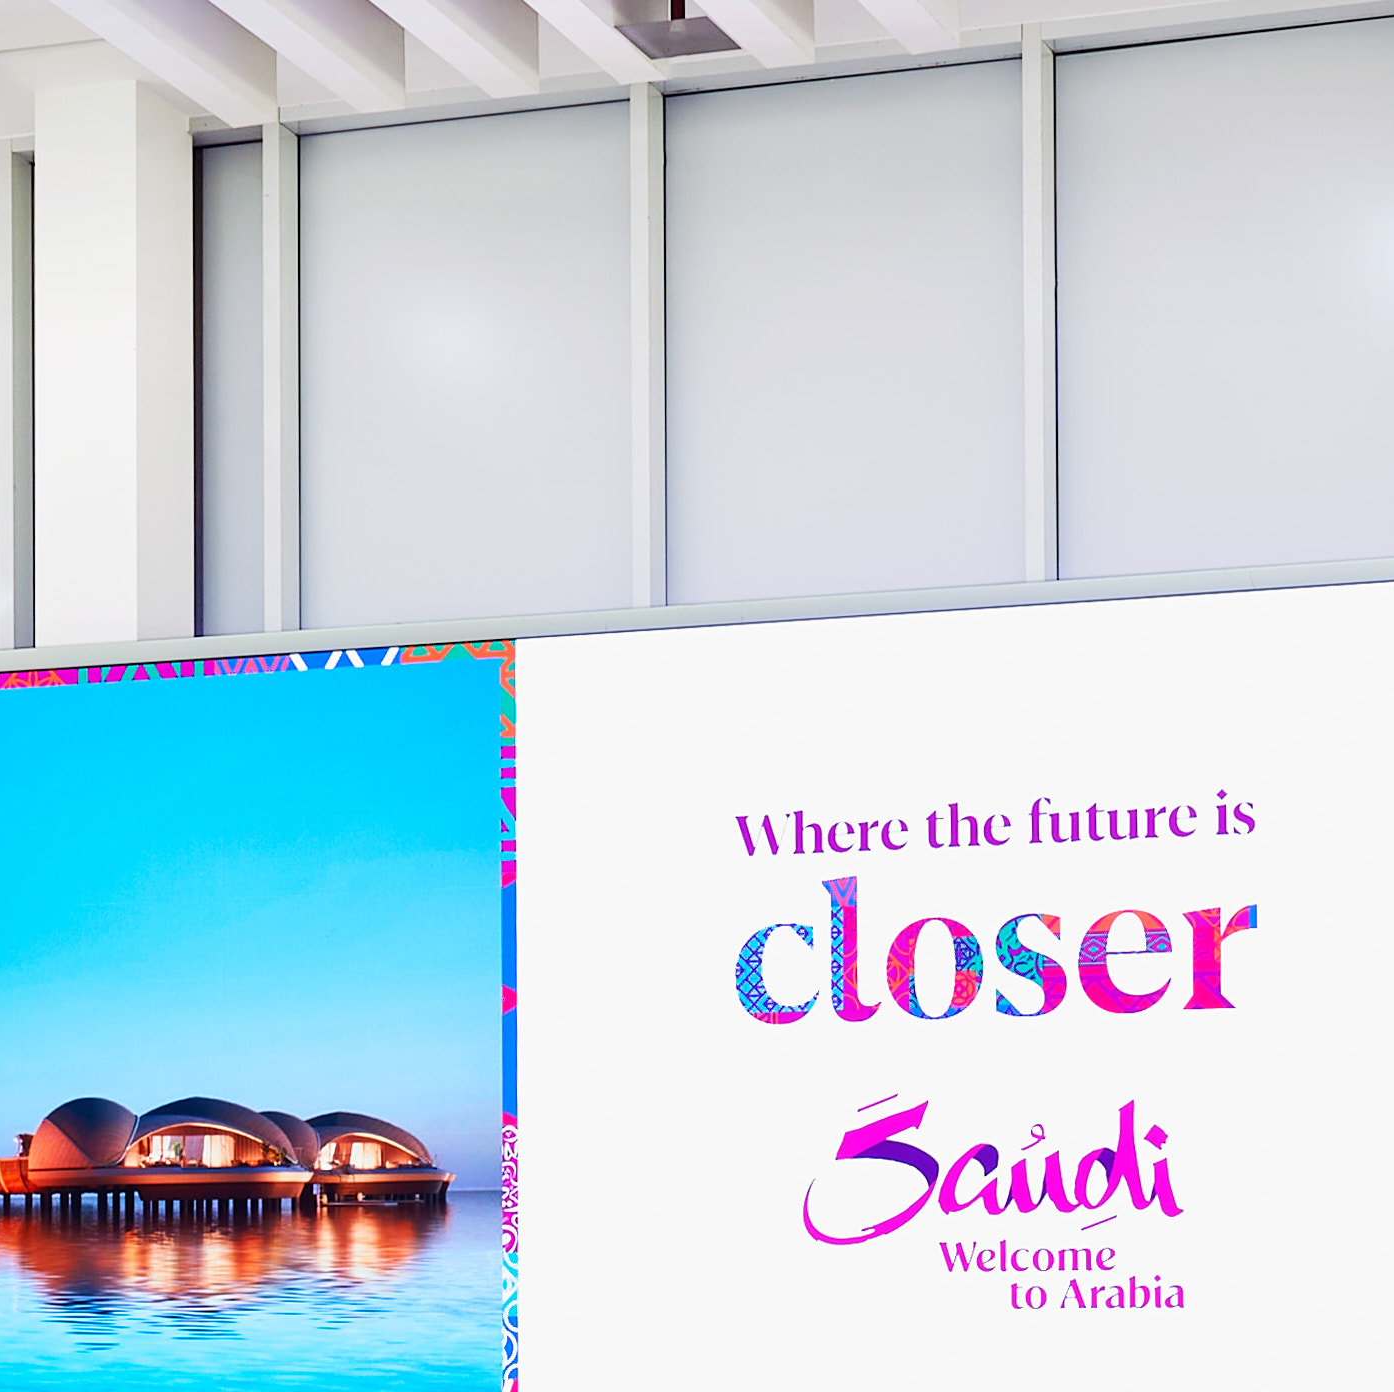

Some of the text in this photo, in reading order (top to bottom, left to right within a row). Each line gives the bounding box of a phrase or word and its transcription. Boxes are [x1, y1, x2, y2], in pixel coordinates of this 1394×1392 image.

[735, 789, 1256, 856] Where the future is
[735, 876, 1257, 1024] closer
[803, 1094, 1184, 1246] Saudi
[939, 1239, 1116, 1272] Welcome
[1010, 1275, 1185, 1309] to Arabia
